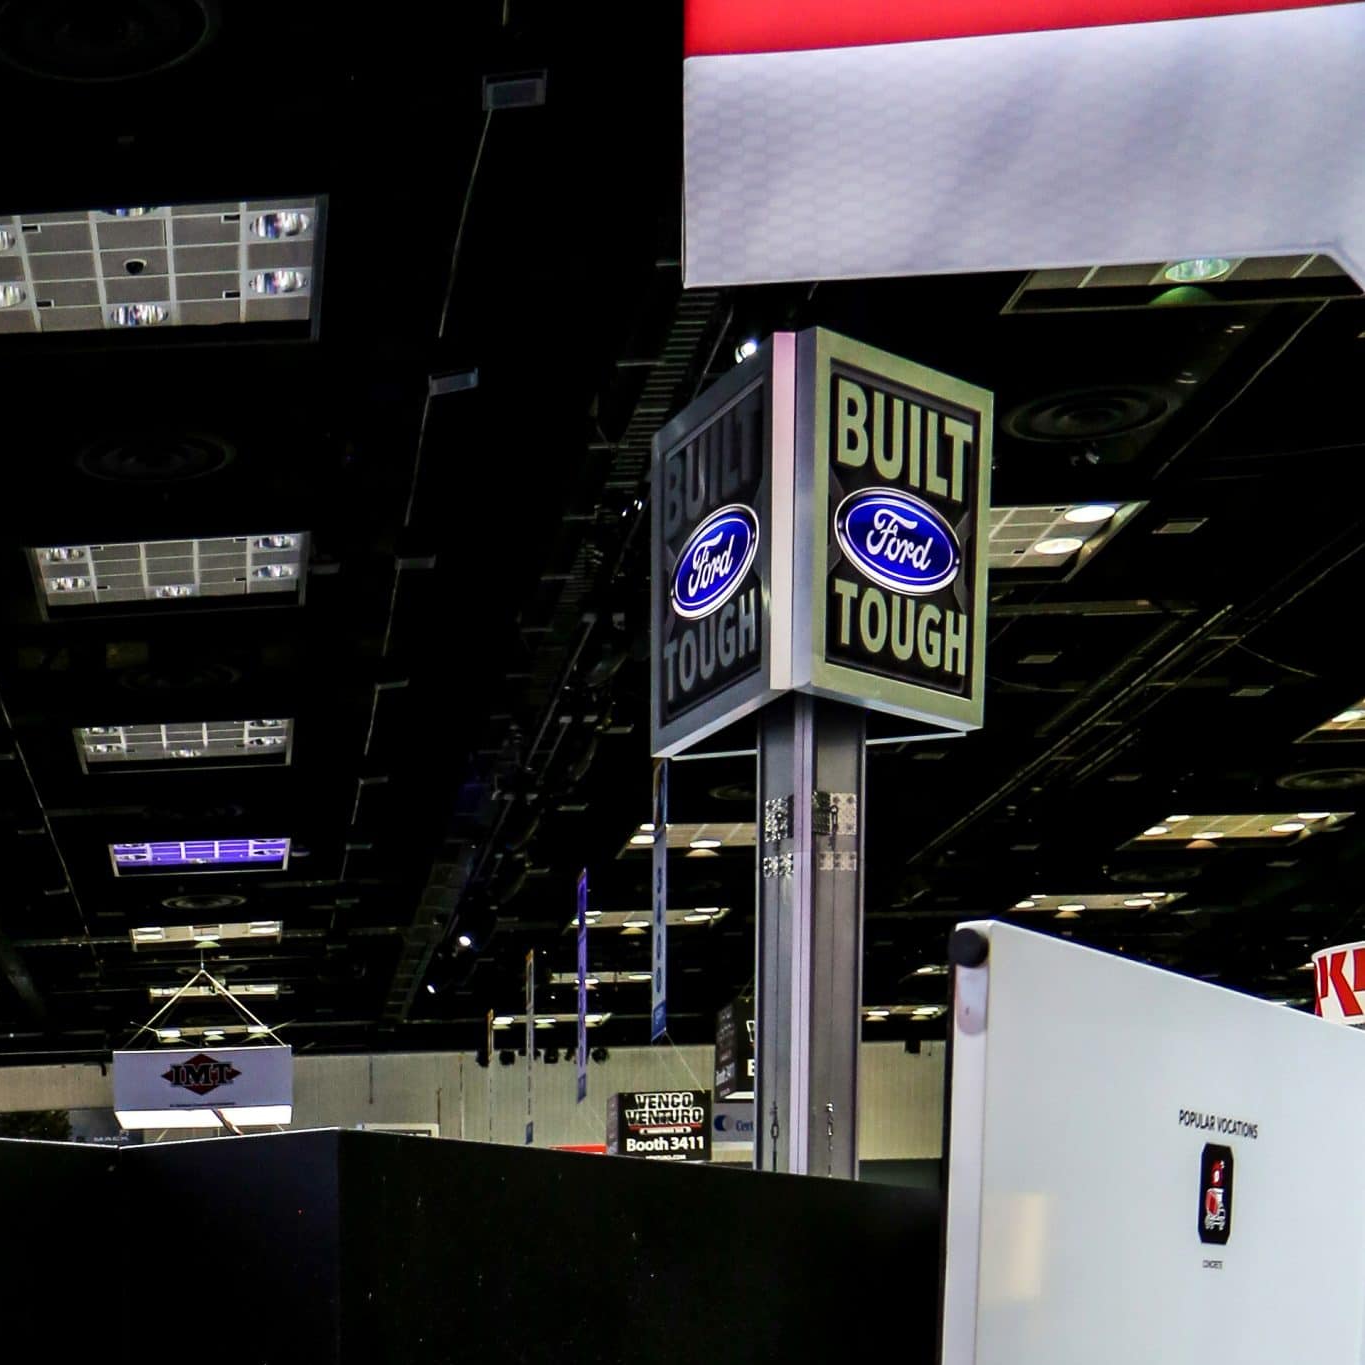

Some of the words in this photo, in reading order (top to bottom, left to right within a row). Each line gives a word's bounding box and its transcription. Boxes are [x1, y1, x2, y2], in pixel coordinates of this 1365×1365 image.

[665, 403, 760, 527] BUILT
[837, 378, 973, 502] BUILT
[687, 531, 736, 597] Ford
[865, 508, 933, 571] Ford
[663, 588, 756, 701] TOUGH
[834, 578, 967, 677] TOUGH
[171, 1063, 233, 1087] IMT
[635, 1092, 694, 1110] VENCO
[625, 1107, 704, 1126] VENTURO
[626, 1137, 669, 1152] Booth
[670, 1136, 704, 1151] 3411
[1179, 1109, 1215, 1131] POPULAR
[1217, 1116, 1259, 1139] VOCATIONS
